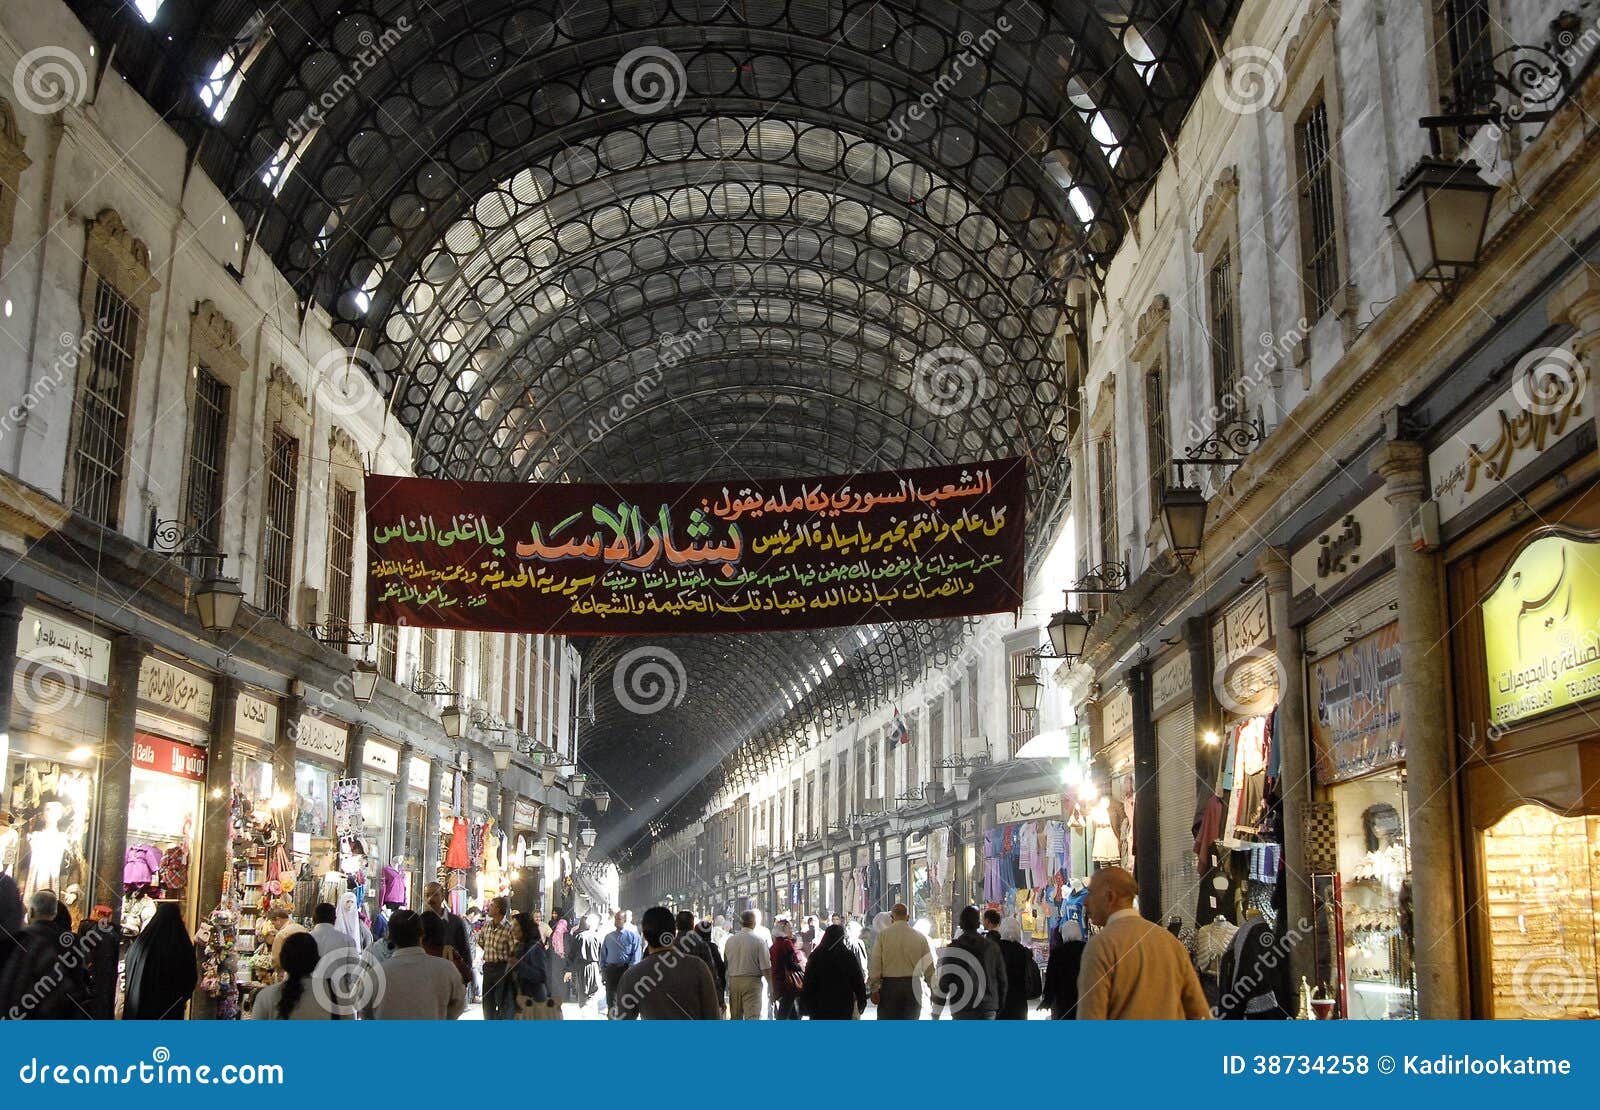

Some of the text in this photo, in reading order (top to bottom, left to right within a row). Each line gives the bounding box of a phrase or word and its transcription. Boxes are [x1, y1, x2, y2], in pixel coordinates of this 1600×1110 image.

[764, 483, 829, 518] بكامله
[832, 478, 916, 517] السوري
[918, 469, 992, 507] الشعب
[373, 514, 436, 544] الناس
[870, 516, 908, 552] بخير
[951, 507, 983, 544] عام
[983, 505, 1007, 537] كل
[621, 503, 744, 579] بشار
[751, 519, 812, 556] الرئيس
[481, 561, 536, 592] الحديثة
[537, 566, 596, 595] سورية
[848, 559, 870, 581] لك
[926, 553, 975, 577] سنوات
[570, 592, 645, 618] والشجاعة
[647, 589, 714, 616] الحكيمة
[809, 587, 848, 608] الله
